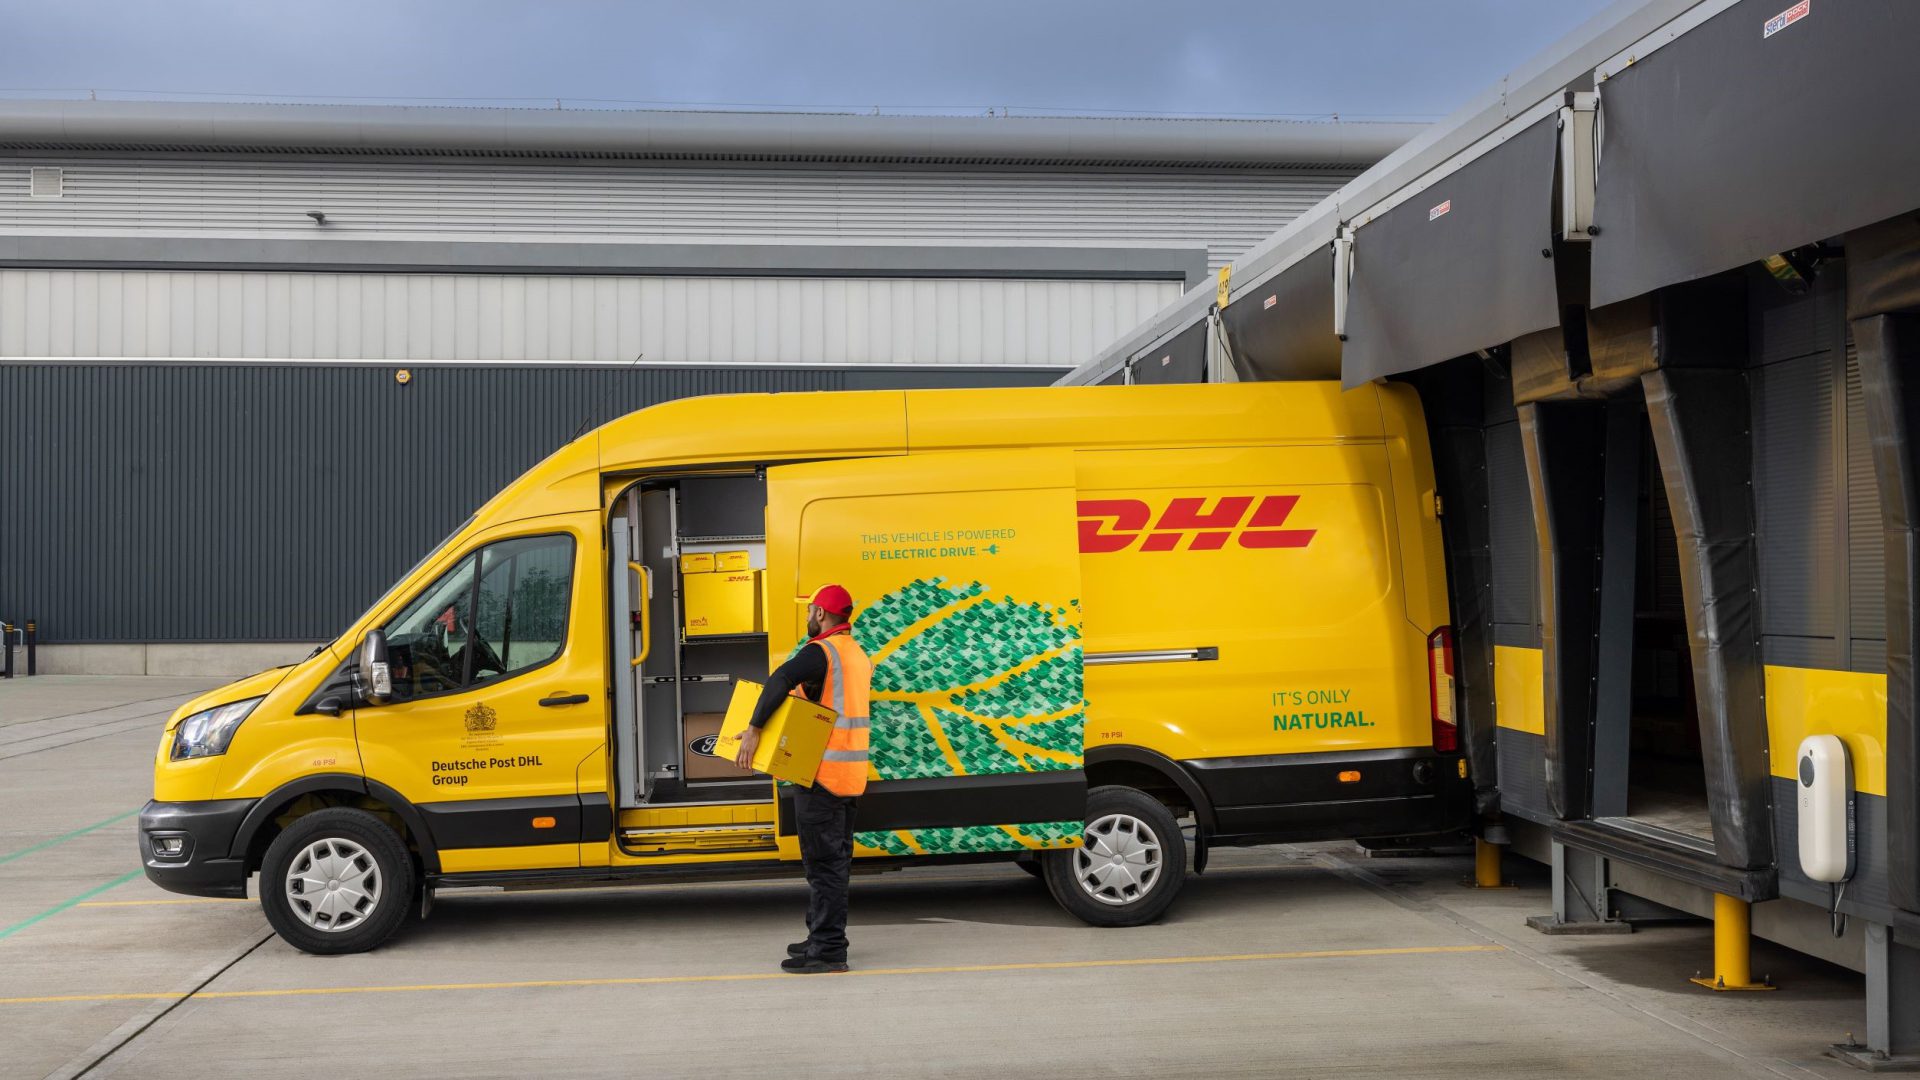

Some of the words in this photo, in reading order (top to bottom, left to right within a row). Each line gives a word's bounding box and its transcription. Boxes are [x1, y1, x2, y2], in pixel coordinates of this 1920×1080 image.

[1077, 495, 1318, 553] DHL
[862, 534, 888, 544] THIS
[891, 531, 940, 543] VEHICLE
[943, 530, 954, 541] IS
[957, 528, 1016, 541] POWERED
[862, 551, 877, 561] BY
[880, 547, 937, 560] ELECTRIC
[1307, 689, 1351, 705] ONLY
[1273, 710, 1375, 731] NATURAL.
[323, 758, 337, 766] PSI
[432, 758, 487, 772] Deutsche
[489, 757, 516, 769] Post
[518, 756, 543, 768] DHL
[432, 774, 468, 787] Group
